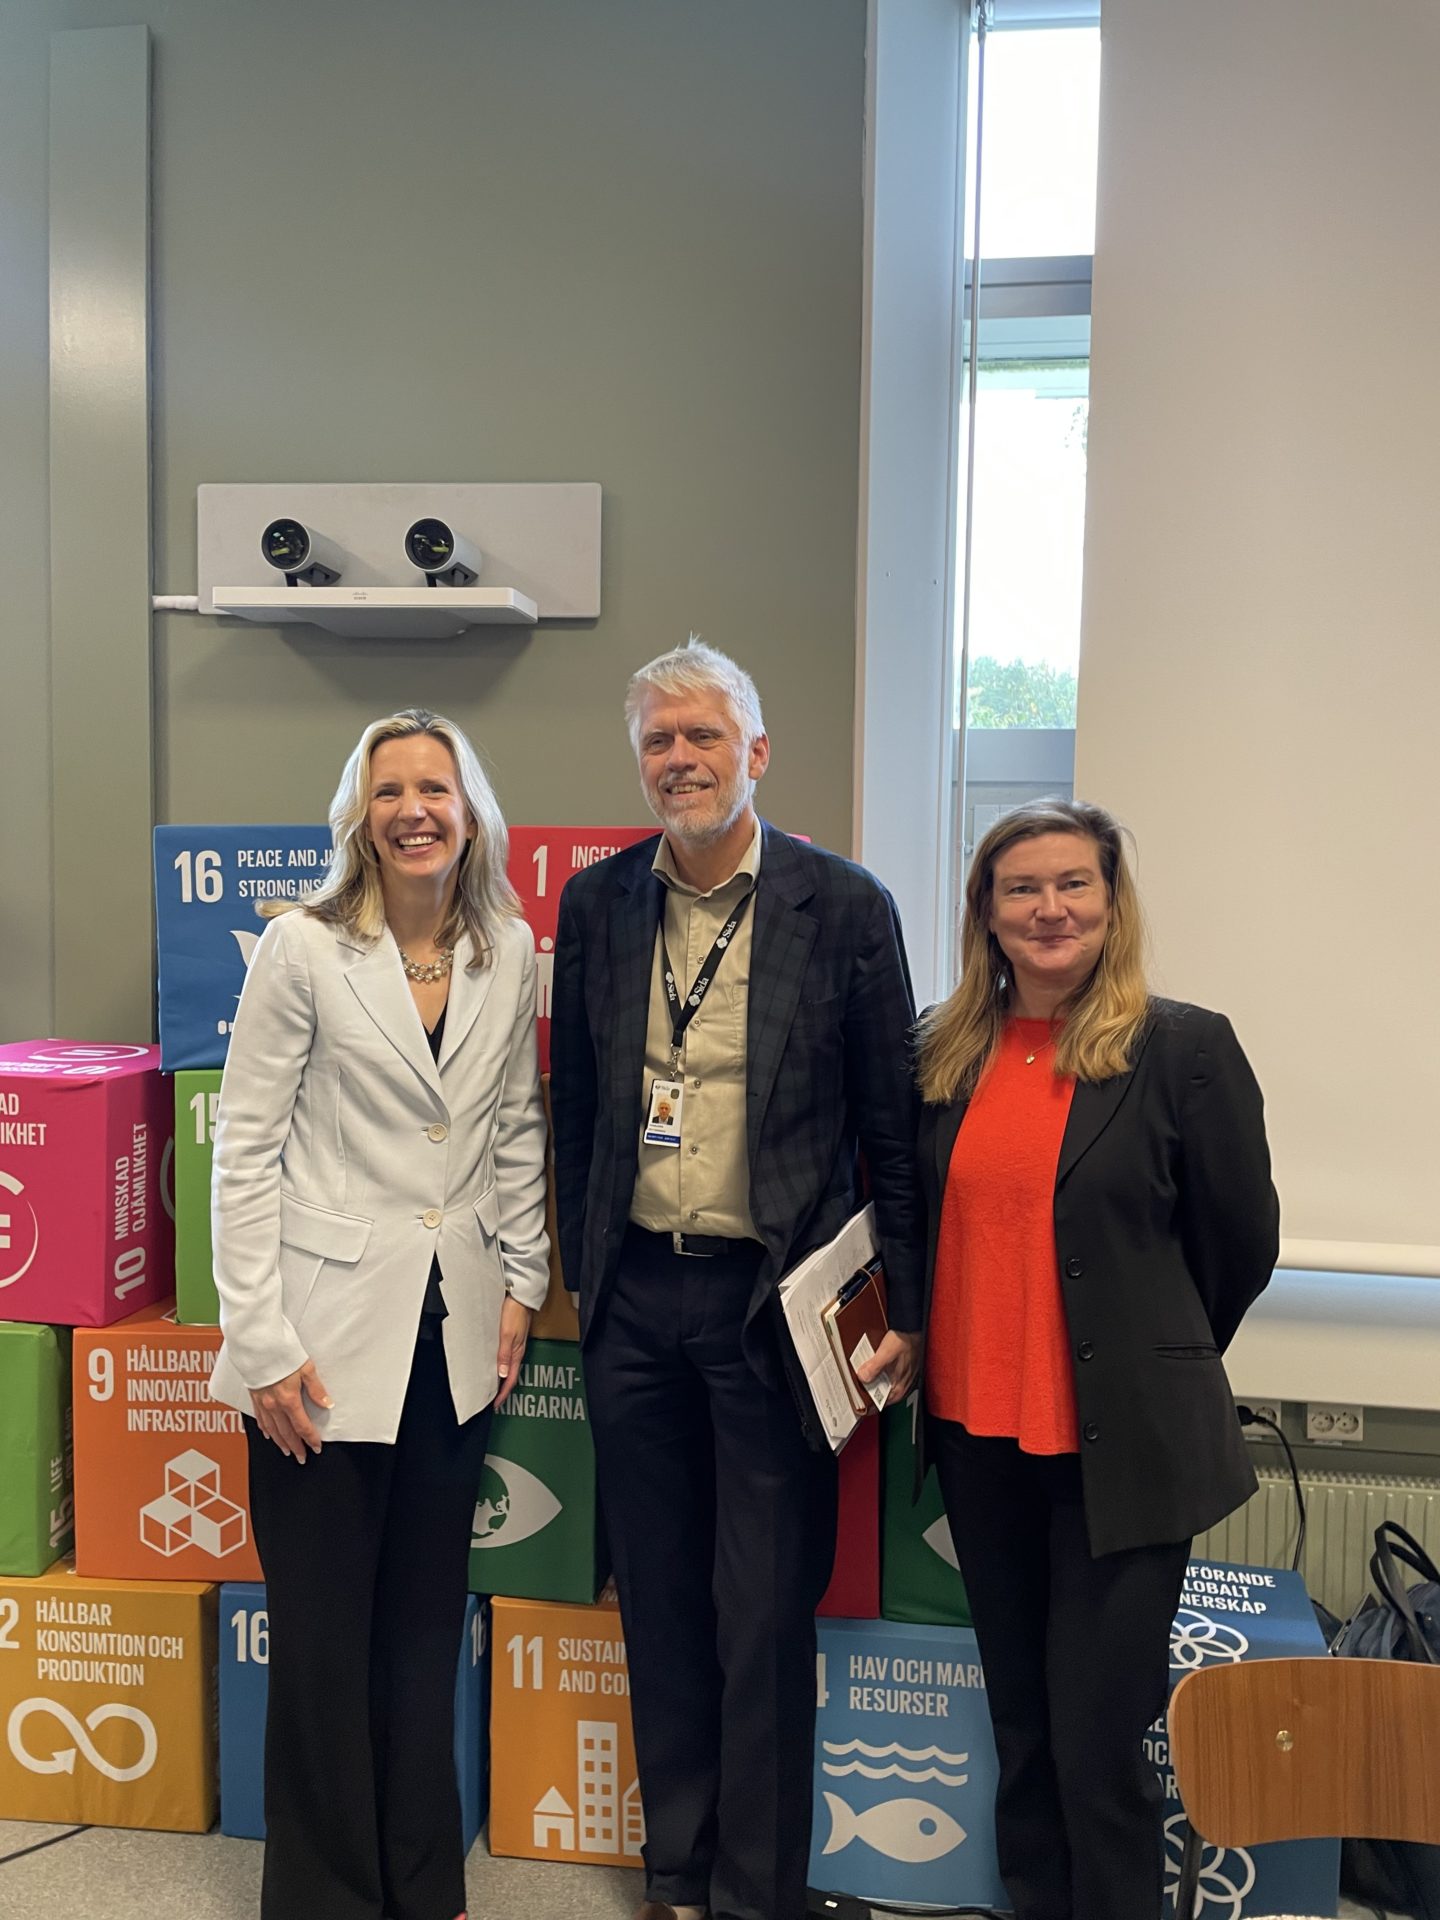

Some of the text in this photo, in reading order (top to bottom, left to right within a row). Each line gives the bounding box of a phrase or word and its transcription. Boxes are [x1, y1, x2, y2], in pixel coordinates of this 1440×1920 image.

[237, 850, 283, 867] PEACE
[287, 849, 317, 867] AND
[532, 845, 548, 897] 1
[174, 850, 224, 903] 16
[238, 879, 296, 897] STRONG
[132, 1123, 147, 1233] OJÄMLIKHET
[114, 1156, 129, 1241] MINSKAD
[114, 1246, 146, 1301] 10
[126, 1344, 202, 1373] HÅLLBAR
[88, 1348, 115, 1402] 9
[36, 1596, 112, 1626] HÅLLBAR
[36, 1629, 183, 1660] KONSUMTION OCH
[231, 1609, 269, 1665] 16
[37, 1657, 144, 1686] PRODUKTION
[507, 1634, 544, 1691] 11
[850, 1654, 888, 1681] HAV
[892, 1658, 932, 1685] OCH
[559, 1668, 630, 1696] AND CO
[850, 1686, 949, 1717] RESURSER
